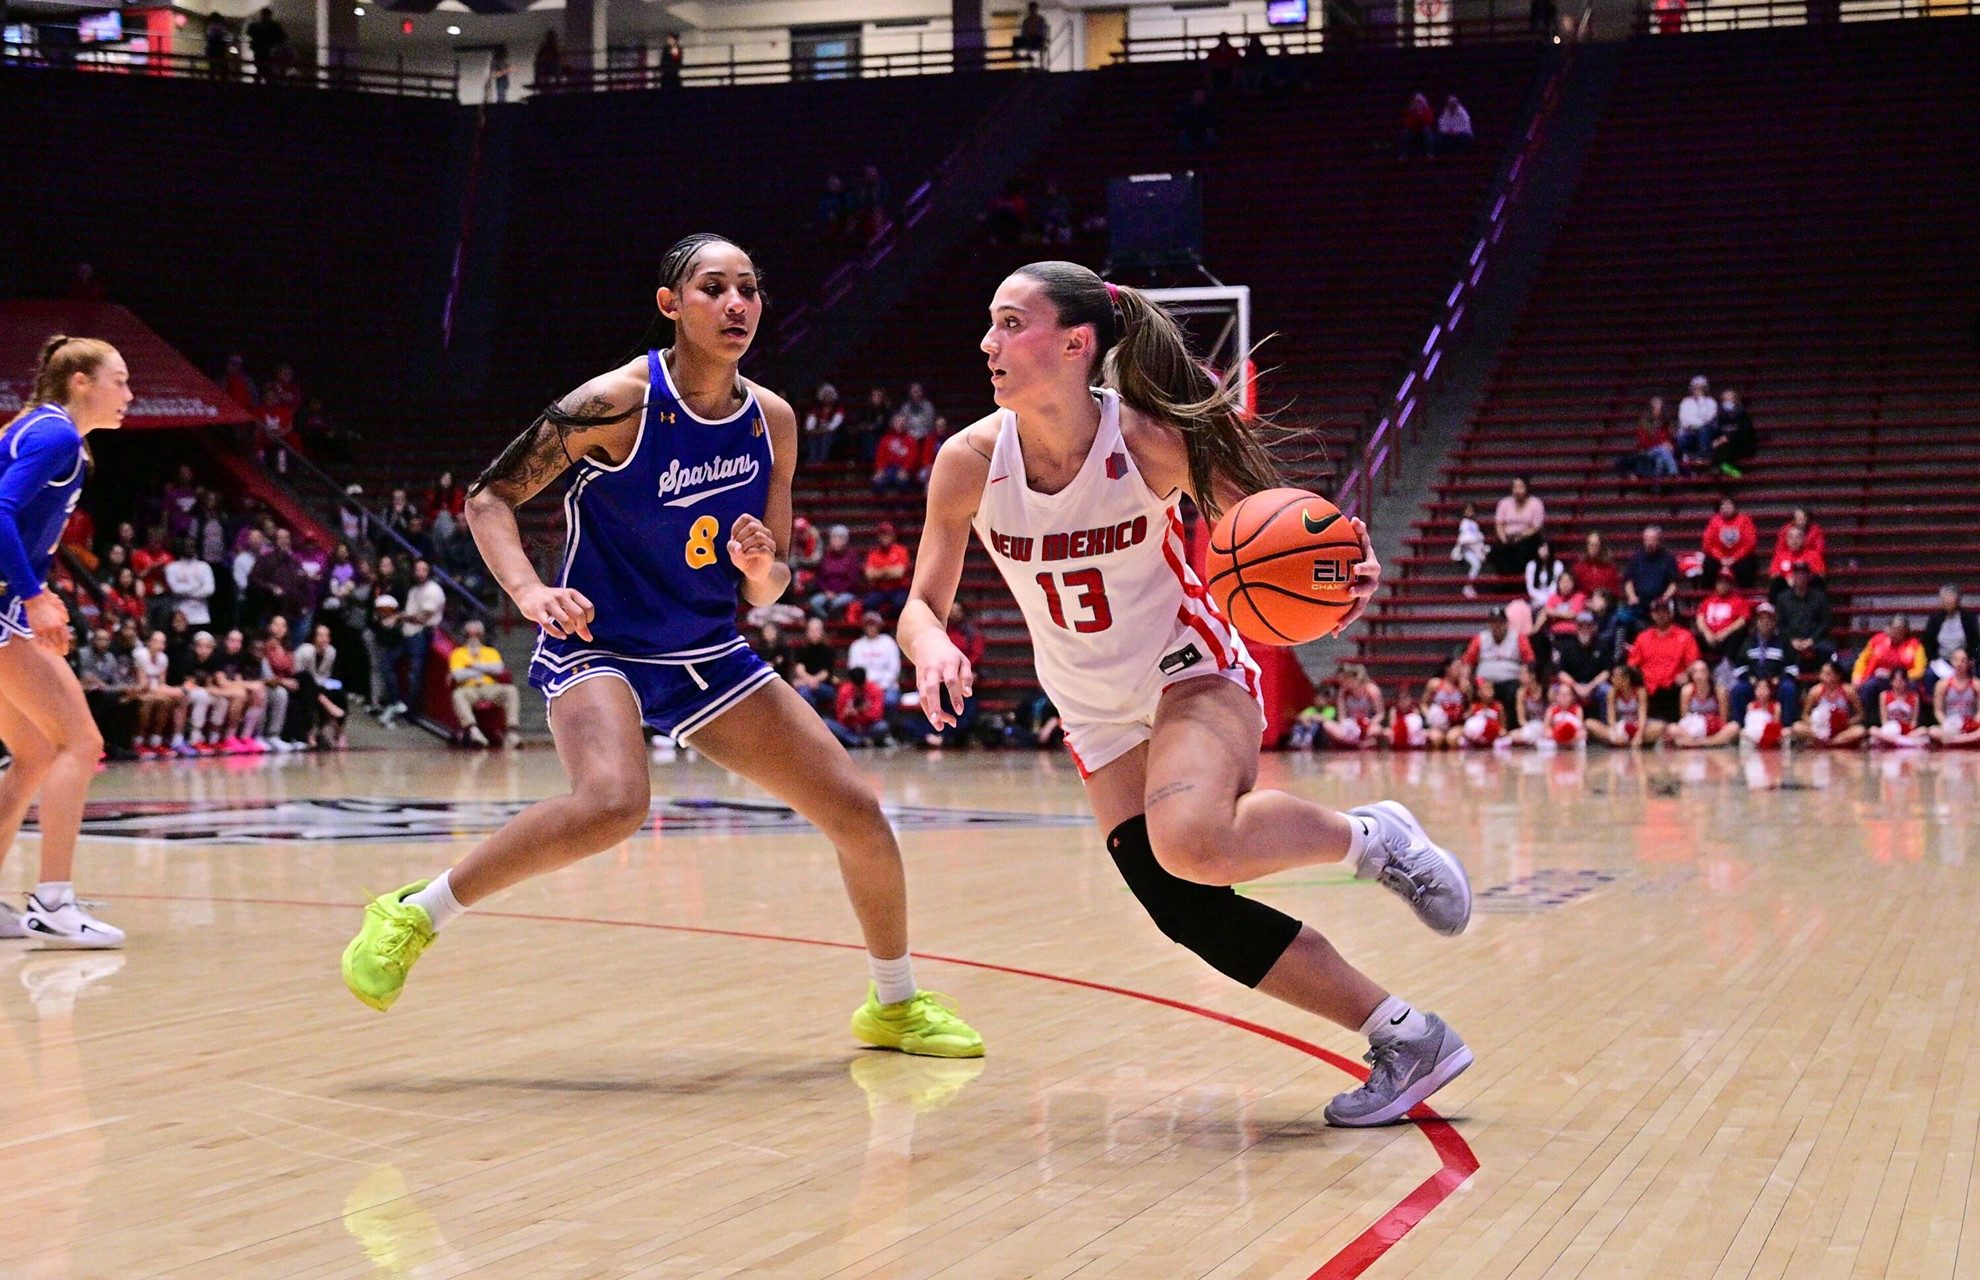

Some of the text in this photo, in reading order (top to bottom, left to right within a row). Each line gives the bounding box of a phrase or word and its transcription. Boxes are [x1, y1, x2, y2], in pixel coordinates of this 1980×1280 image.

[657, 453, 759, 498] Spartans
[685, 515, 719, 569] 8
[1042, 515, 1147, 562] MEXICO
[1036, 567, 1113, 633] 13
[1184, 651, 1195, 661] M
